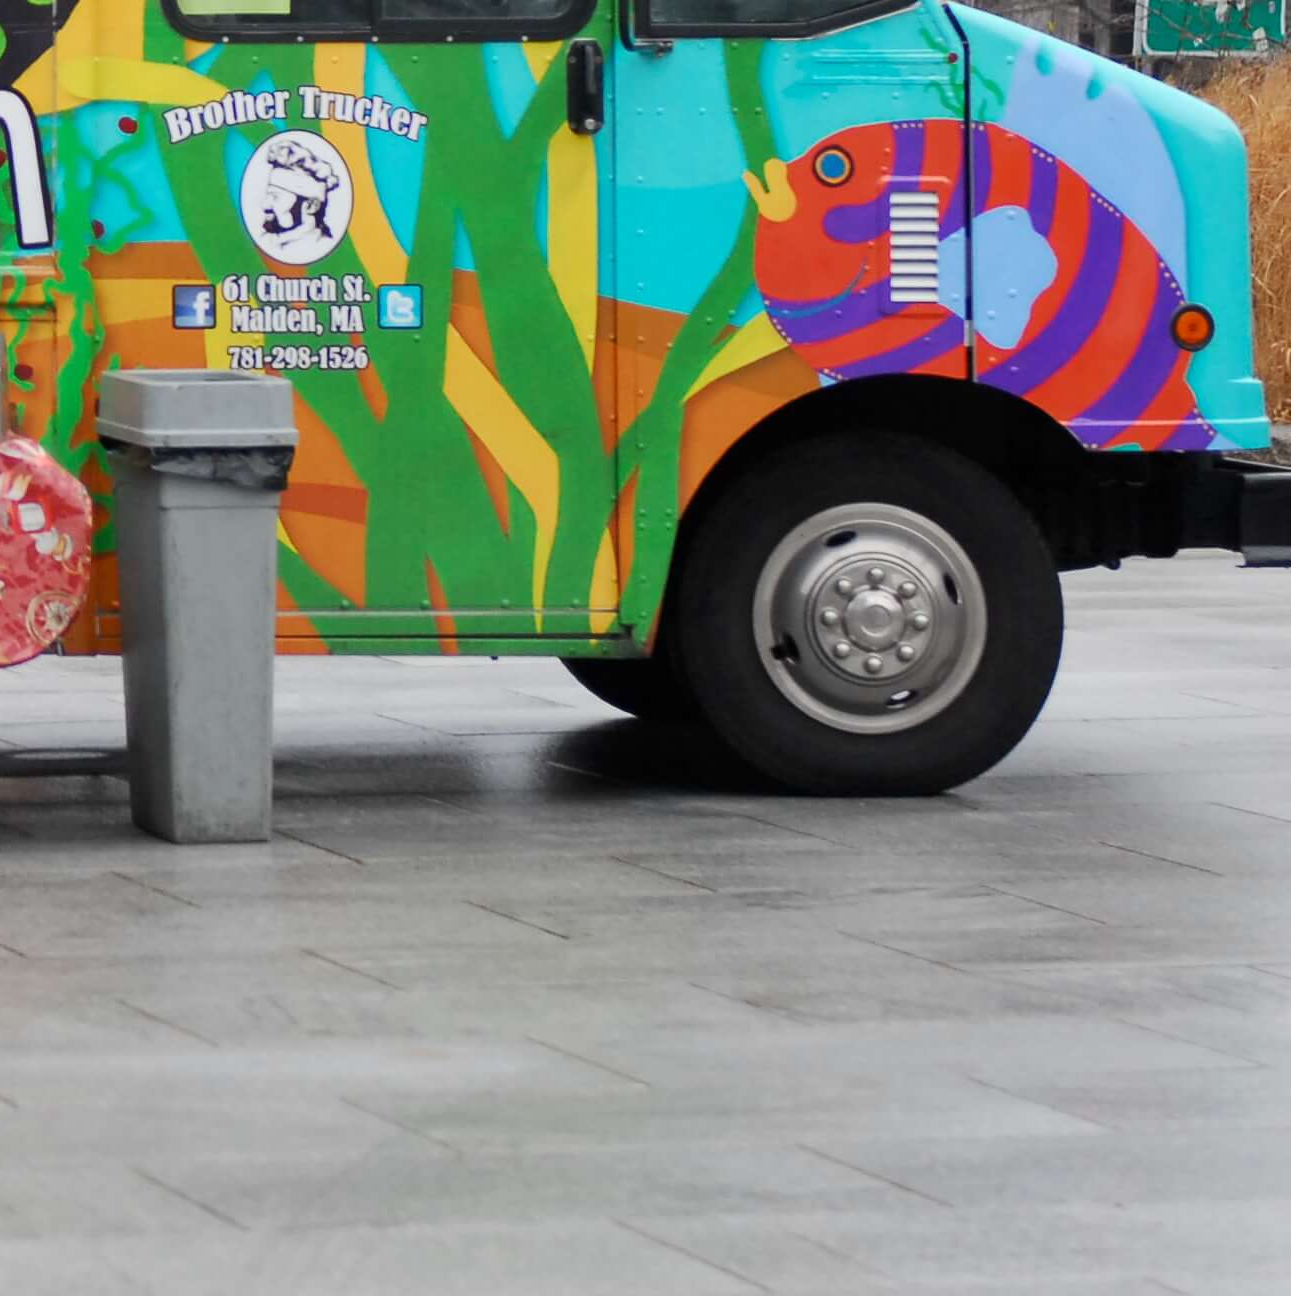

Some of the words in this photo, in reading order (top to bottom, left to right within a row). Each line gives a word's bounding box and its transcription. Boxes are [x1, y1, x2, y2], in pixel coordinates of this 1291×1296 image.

[162, 88, 291, 145] Brother
[298, 85, 428, 142] Trucker
[222, 275, 250, 302] 61
[256, 274, 337, 302] Church
[343, 275, 372, 302] St.
[230, 305, 323, 336] Malden,
[330, 305, 364, 334] MA
[227, 346, 369, 370] 781-298-1526
